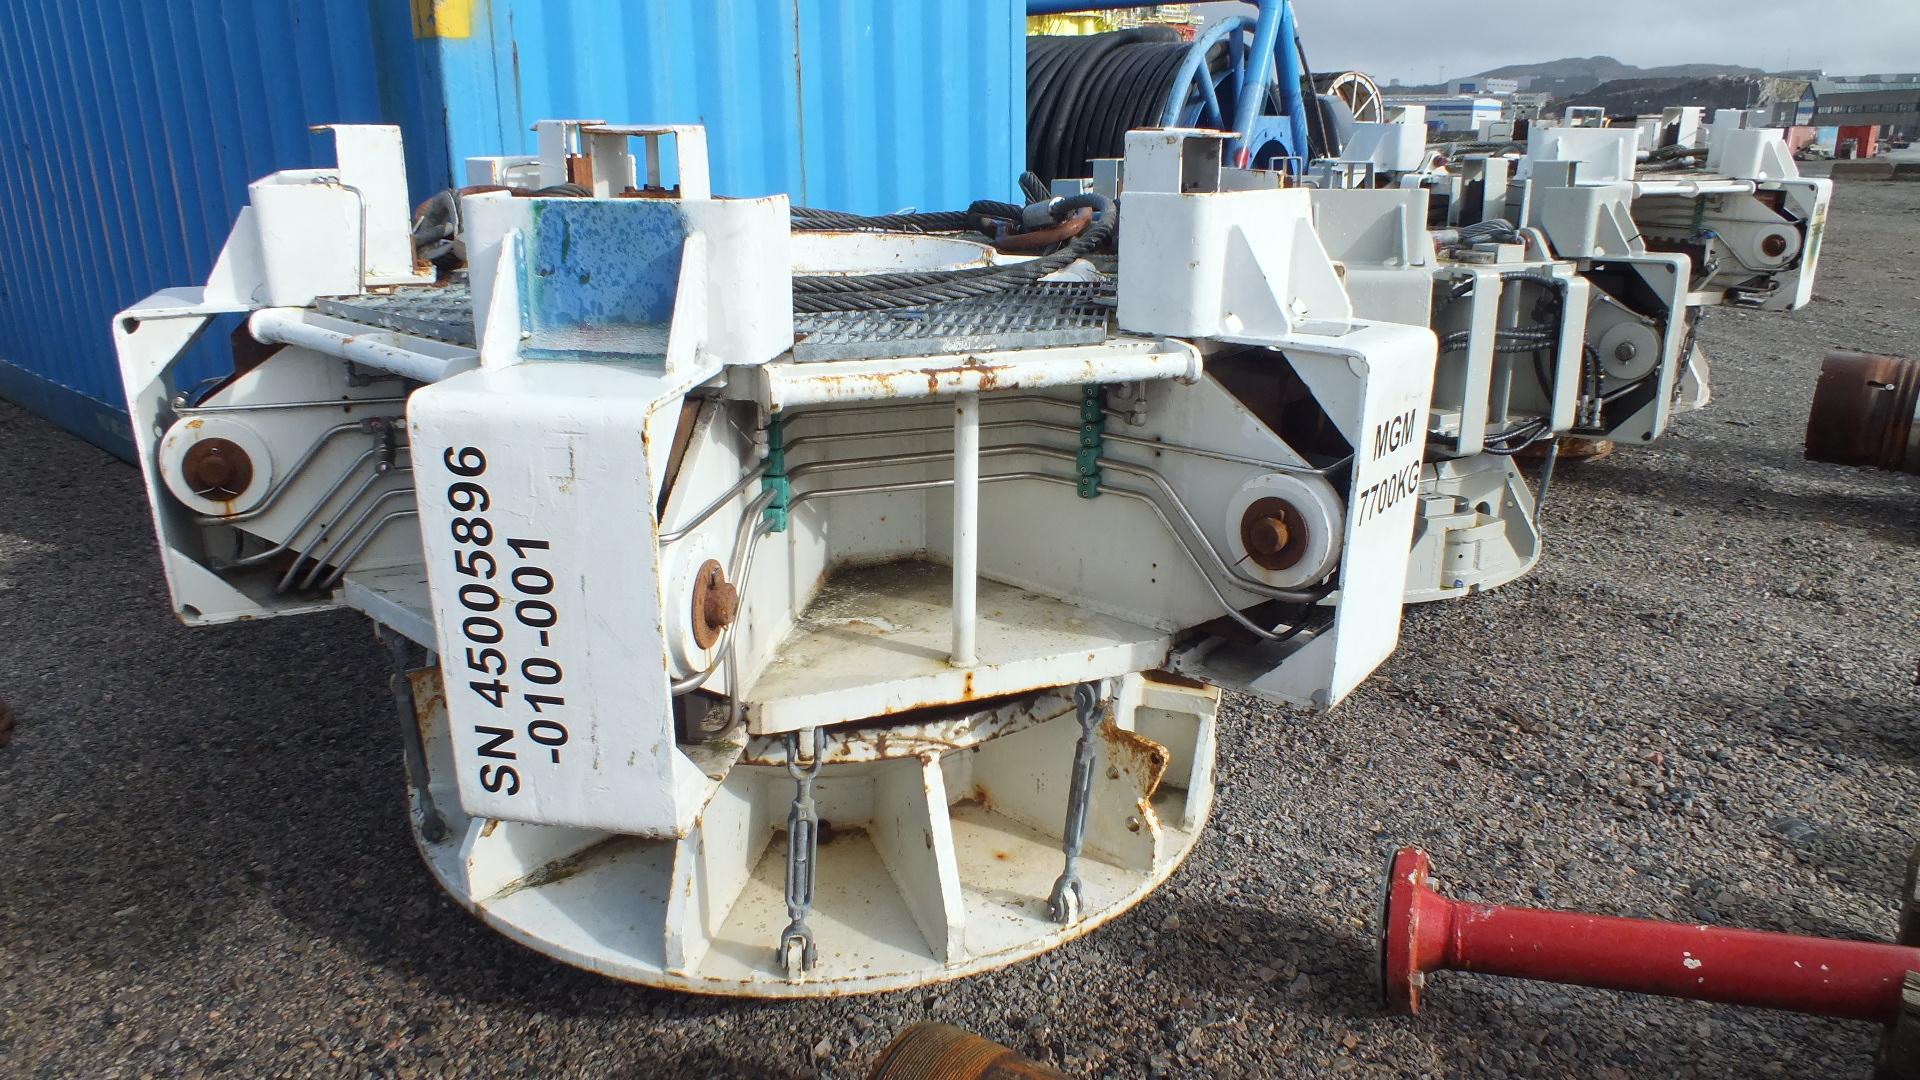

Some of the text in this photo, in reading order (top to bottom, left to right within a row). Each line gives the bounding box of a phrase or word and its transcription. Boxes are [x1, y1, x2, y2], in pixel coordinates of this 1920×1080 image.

[1373, 408, 1416, 461] MGM
[1358, 459, 1420, 527] 7700KG
[443, 446, 521, 796] SN 45005896
